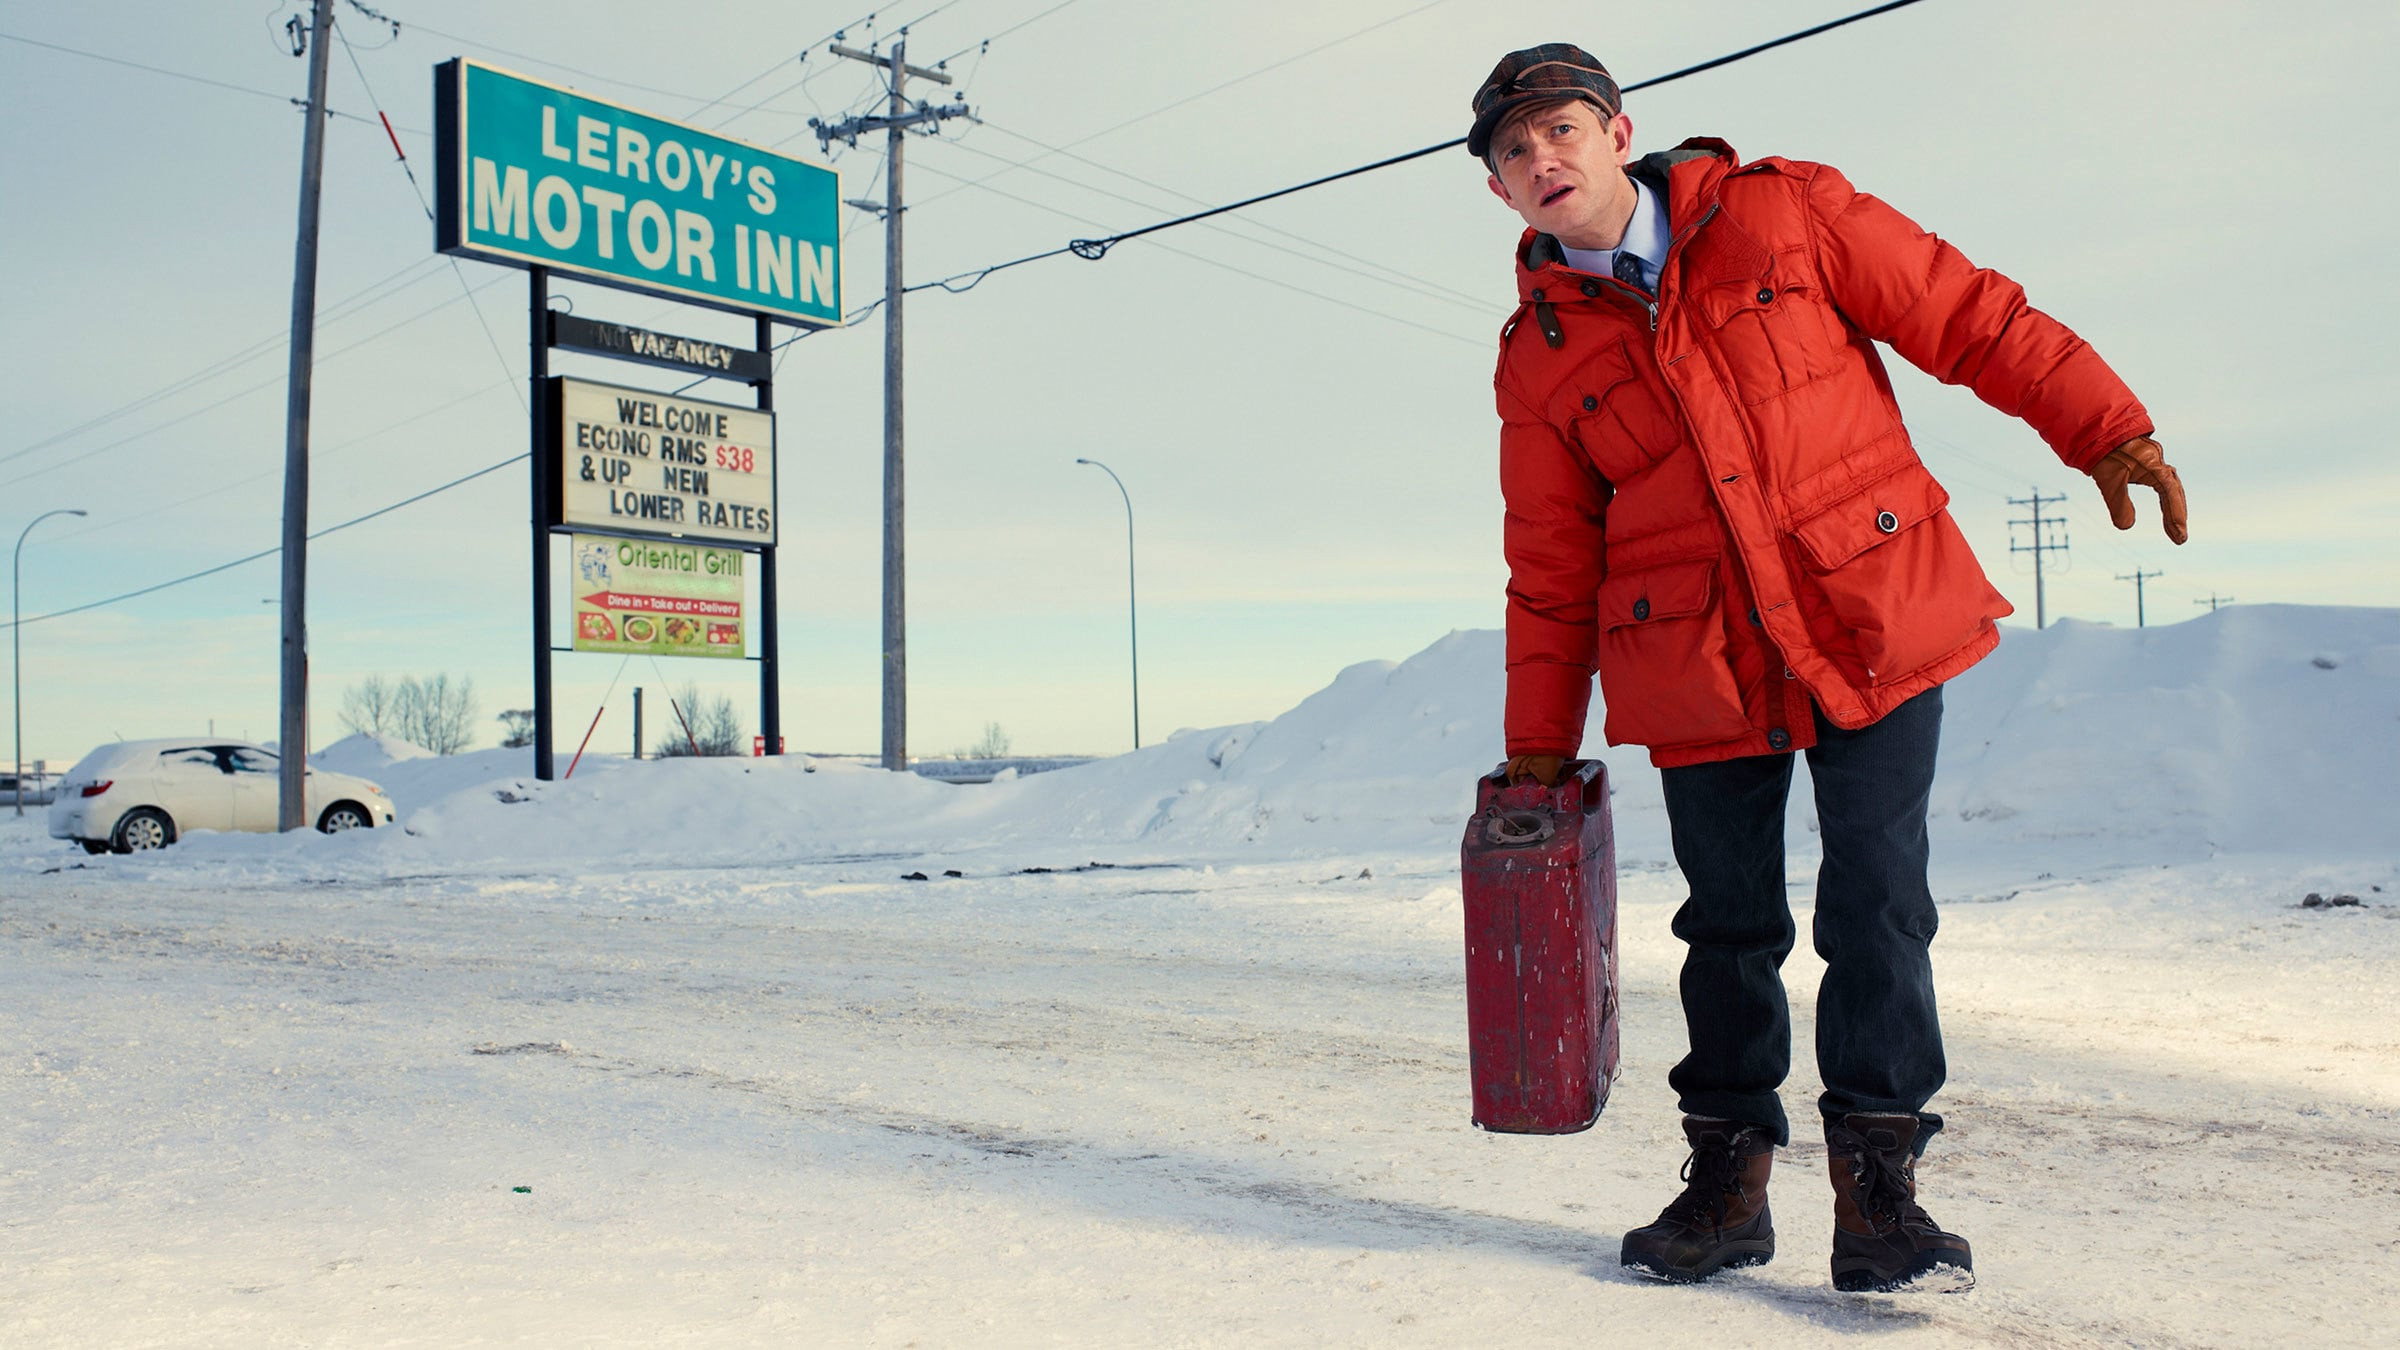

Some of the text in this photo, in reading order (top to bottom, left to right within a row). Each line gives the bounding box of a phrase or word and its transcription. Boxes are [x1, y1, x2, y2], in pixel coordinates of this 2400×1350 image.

[542, 104, 777, 216] LEROY'S
[473, 156, 835, 309] MOTOR INN
[629, 330, 734, 370] VACANCY
[616, 397, 728, 439] WELCOME
[577, 423, 754, 473] ECONO RMS $38
[580, 454, 709, 496] & UP NEW
[610, 489, 770, 533] LOWER RATES
[618, 542, 742, 576] Oriental Grill
[607, 594, 738, 616] Dine in Take out Delivery
